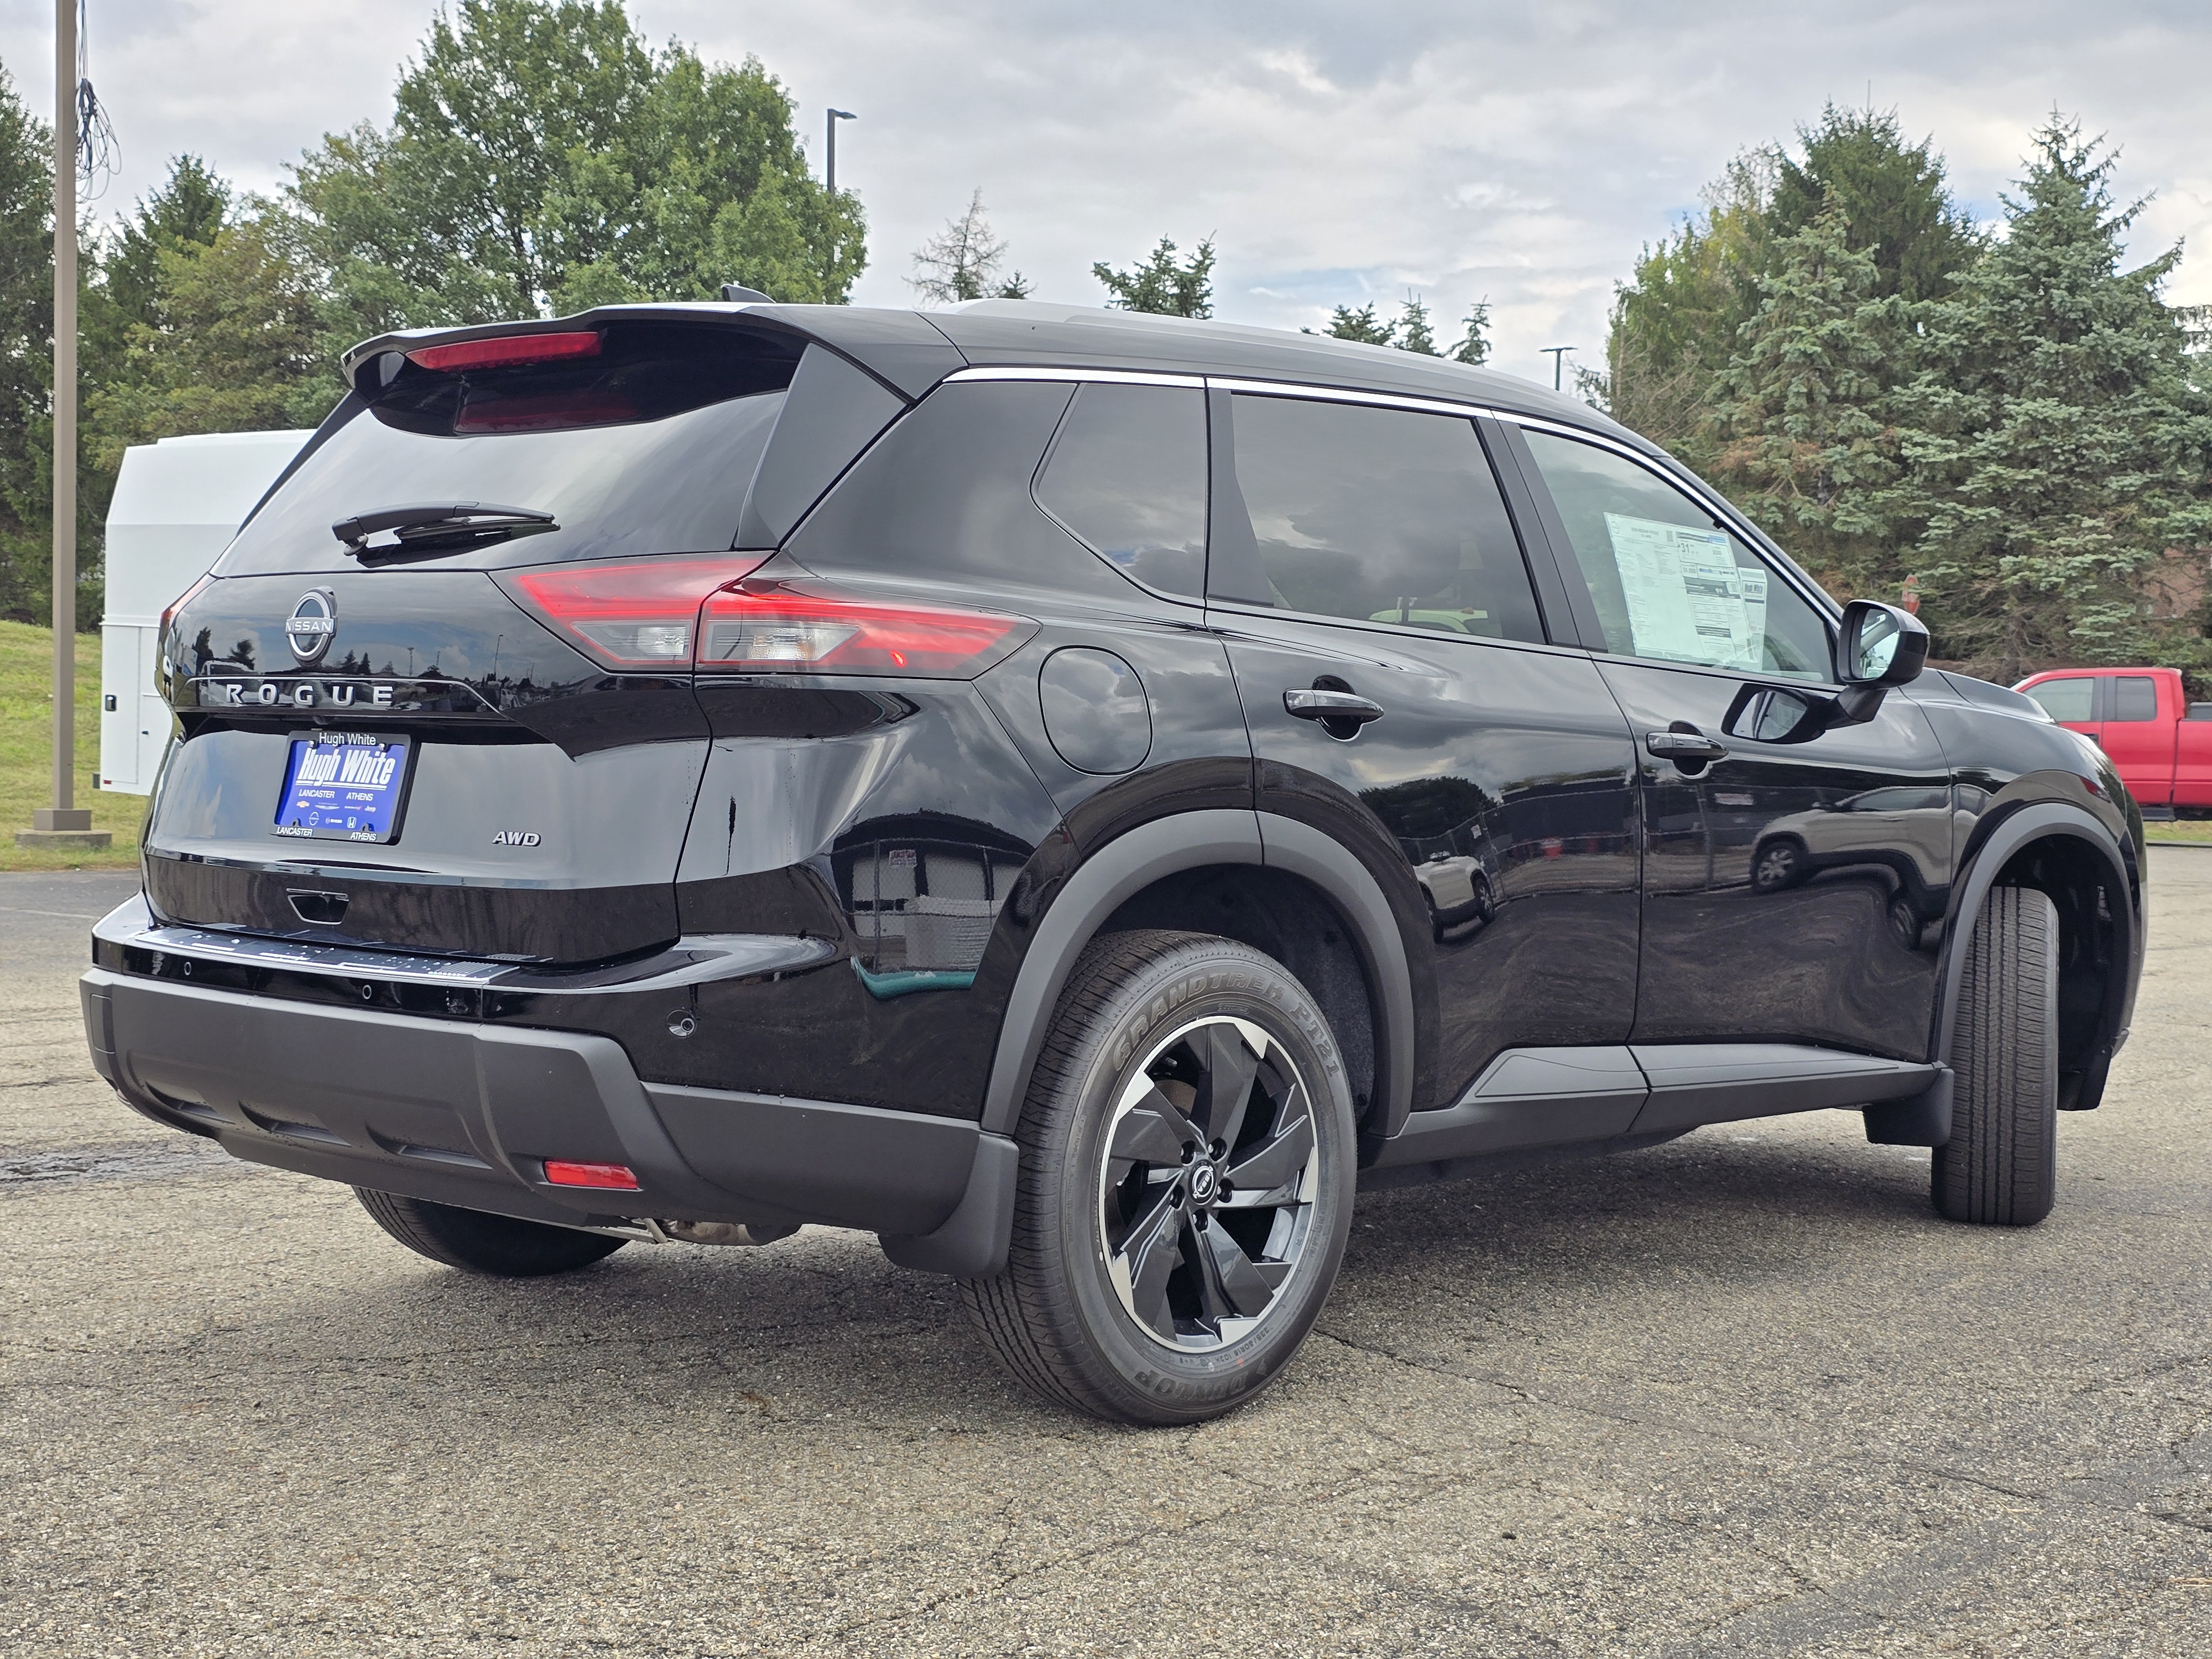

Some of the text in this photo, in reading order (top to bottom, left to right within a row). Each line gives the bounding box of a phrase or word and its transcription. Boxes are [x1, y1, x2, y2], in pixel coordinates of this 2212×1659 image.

[285, 620, 332, 632] NISSAN
[226, 684, 394, 707] ROGUE
[319, 732, 377, 747] Hugh White
[298, 748, 396, 786] Hugh White
[299, 789, 374, 801] LANCASTER ATHENS
[276, 826, 377, 842] LANCASTER ATHENS
[492, 831, 541, 847] AWD
[1113, 971, 1286, 1071] GRANDTREK
[1288, 1001, 1340, 1078] PT21
[1134, 1369, 1250, 1401] DUNLOP
